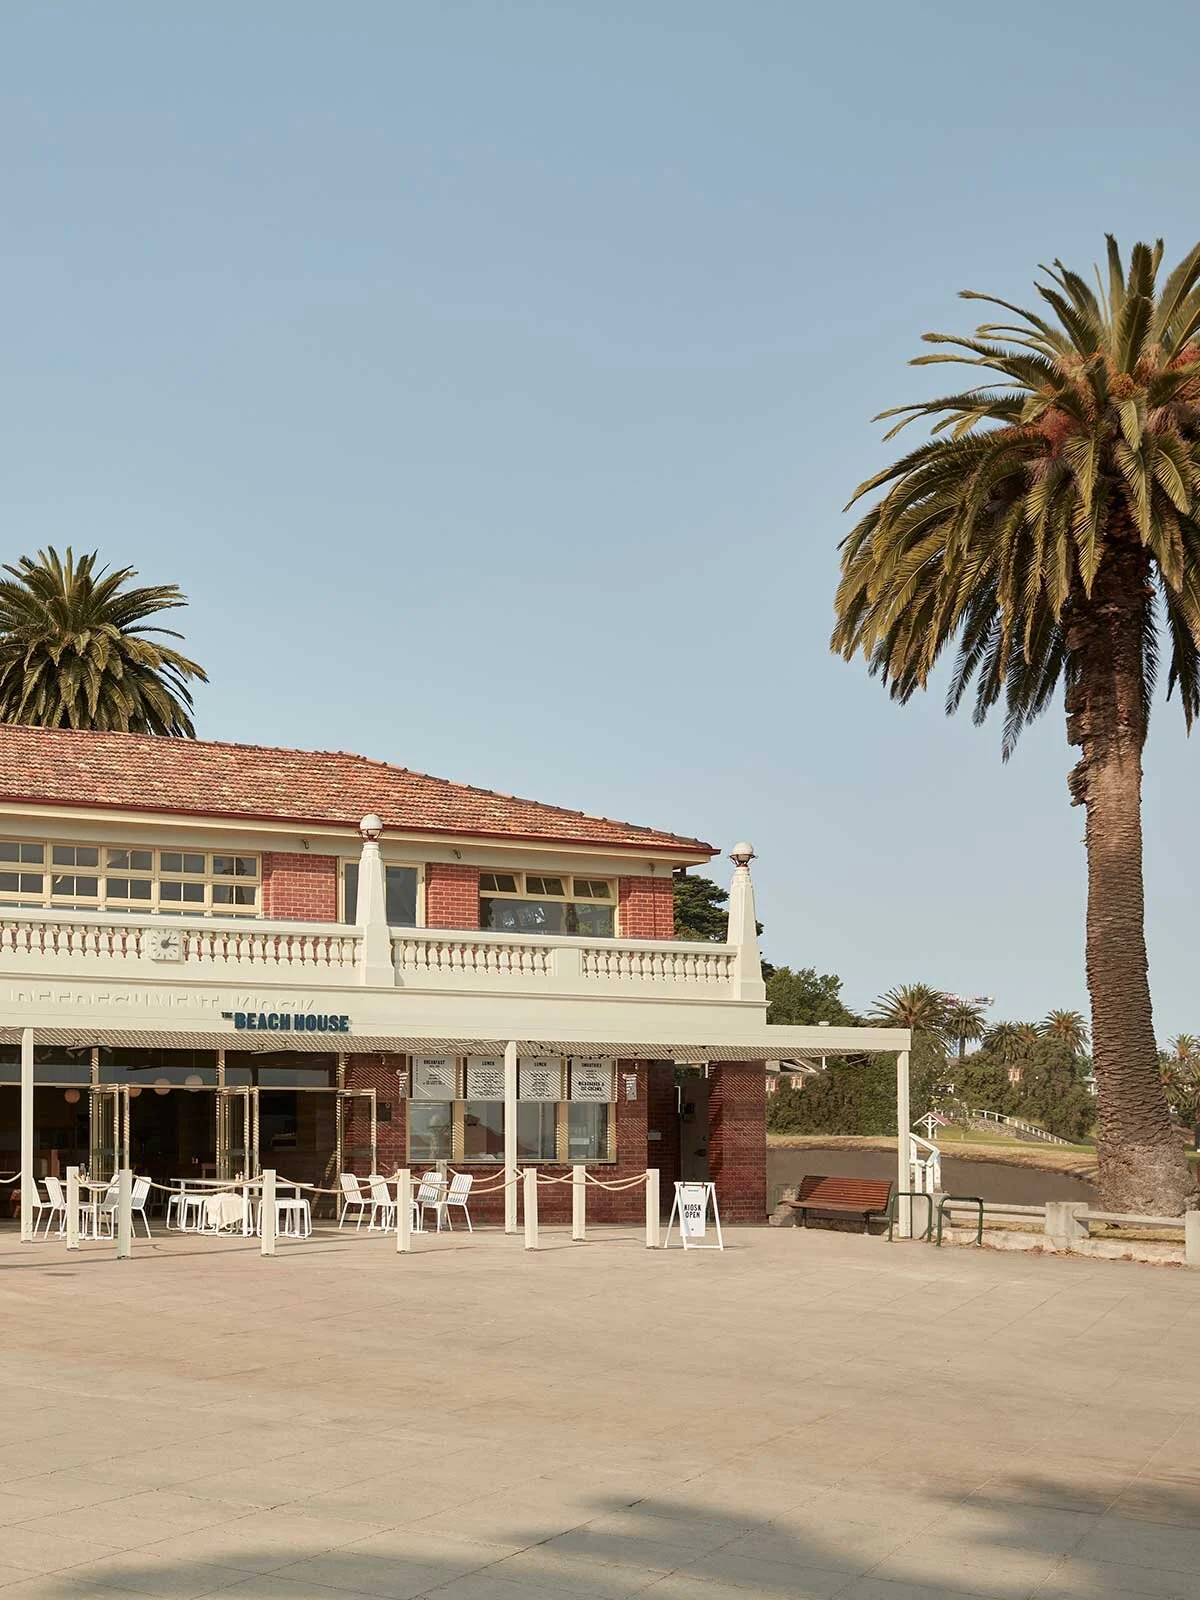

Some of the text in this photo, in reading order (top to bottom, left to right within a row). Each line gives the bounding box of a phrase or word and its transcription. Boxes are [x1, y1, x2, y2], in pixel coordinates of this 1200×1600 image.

[234, 1012, 291, 1030] BEACH
[294, 1014, 349, 1032] HOUSE
[684, 1203, 702, 1211] KIOSK
[684, 1211, 701, 1219] OPEN
